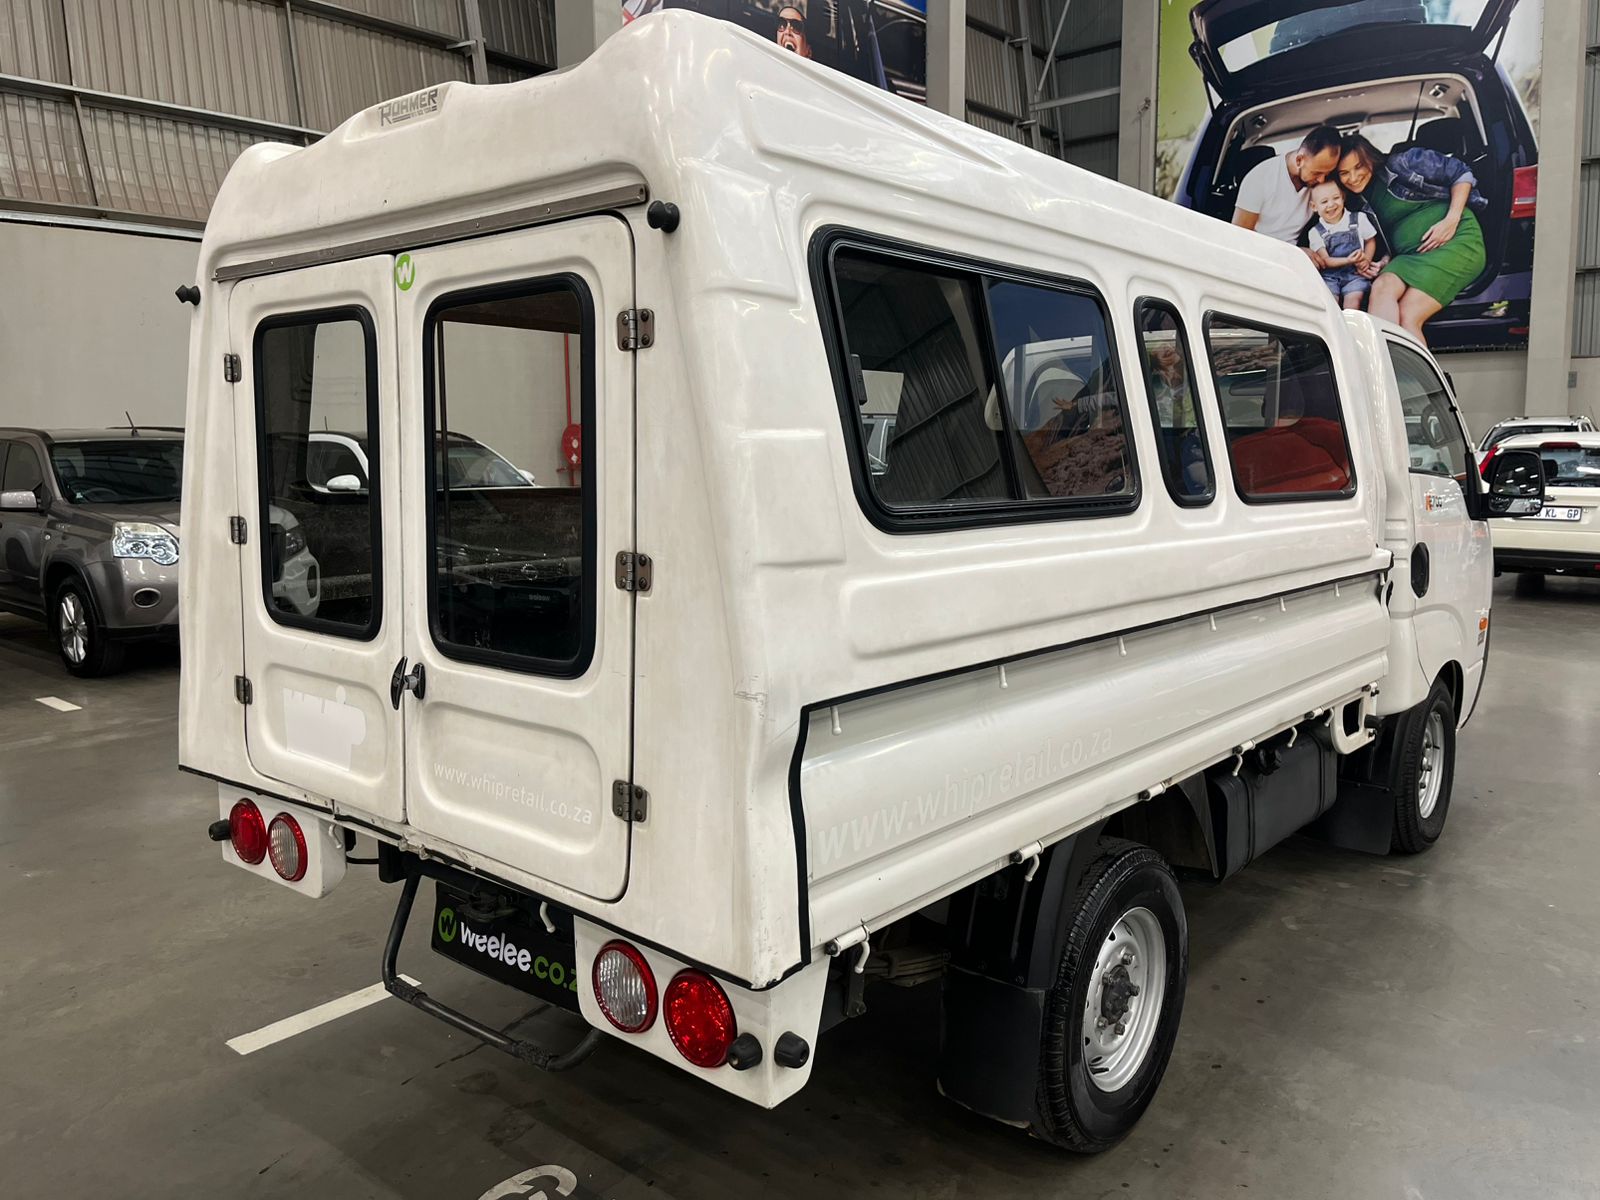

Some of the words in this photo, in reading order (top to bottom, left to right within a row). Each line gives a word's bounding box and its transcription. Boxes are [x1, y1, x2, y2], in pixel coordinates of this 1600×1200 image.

[379, 88, 438, 127] ROAMER
[1567, 508, 1579, 519] GP
[433, 762, 593, 825] www.whipretail.co.za
[818, 727, 1113, 865] www.whipretail.co.za
